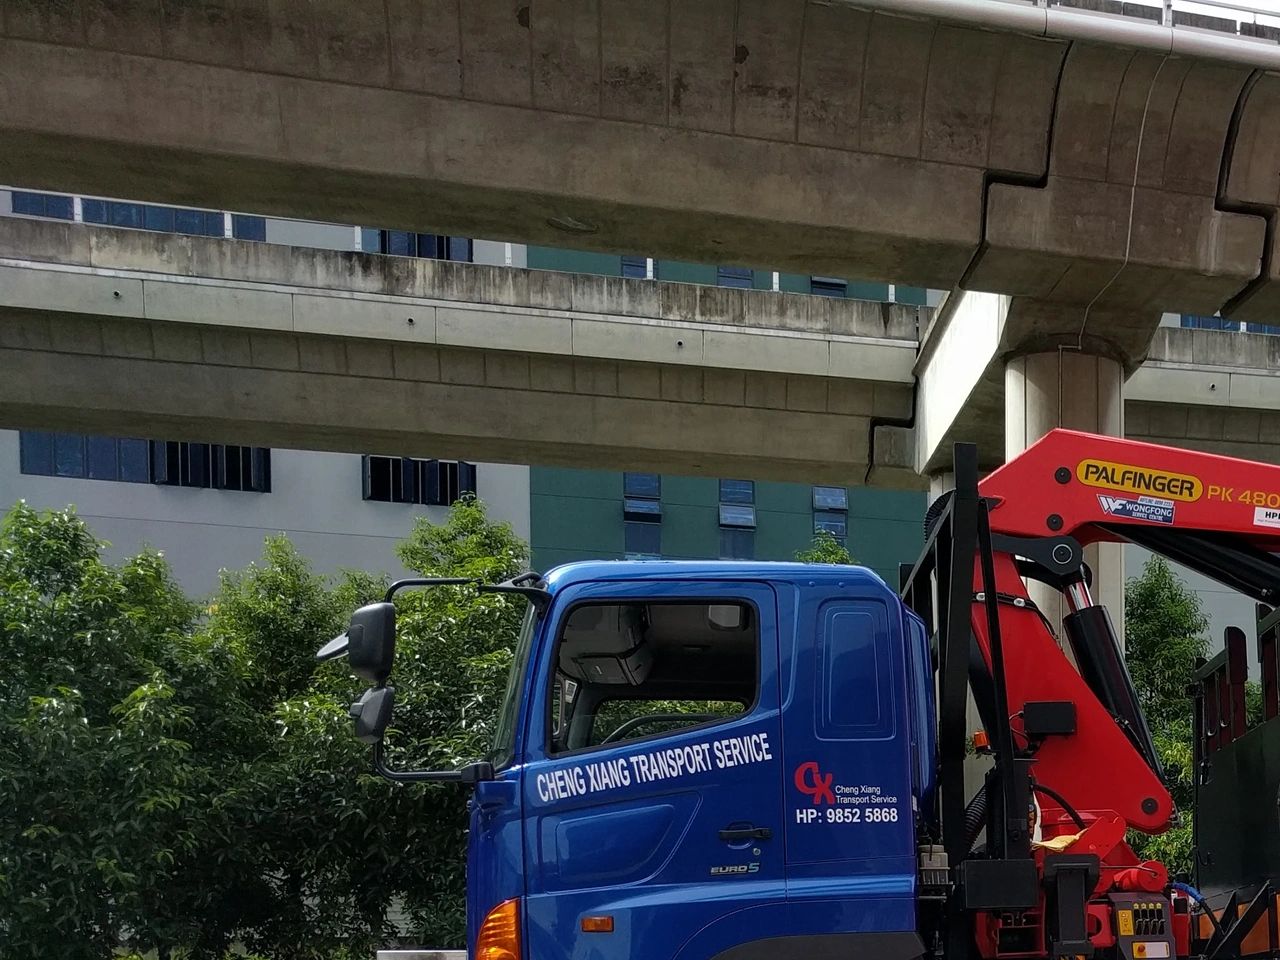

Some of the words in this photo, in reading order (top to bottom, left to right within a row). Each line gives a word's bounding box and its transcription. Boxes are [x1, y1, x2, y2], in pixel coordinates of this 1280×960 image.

[1084, 463, 1195, 497] PALFINGER
[1207, 485, 1233, 502] PK
[1126, 503, 1172, 517] WONGFONG
[537, 766, 588, 802] CHENG
[586, 758, 631, 793] XIANG
[629, 743, 712, 785] TRANSPORT
[713, 733, 773, 769] SERVICE
[835, 785, 859, 795] Cheng
[860, 785, 881, 795] Xiang
[836, 795, 869, 805] Transport
[870, 795, 898, 804] Service
[796, 808, 823, 823] HP:
[826, 808, 861, 823] 9852
[865, 807, 898, 823] 5868
